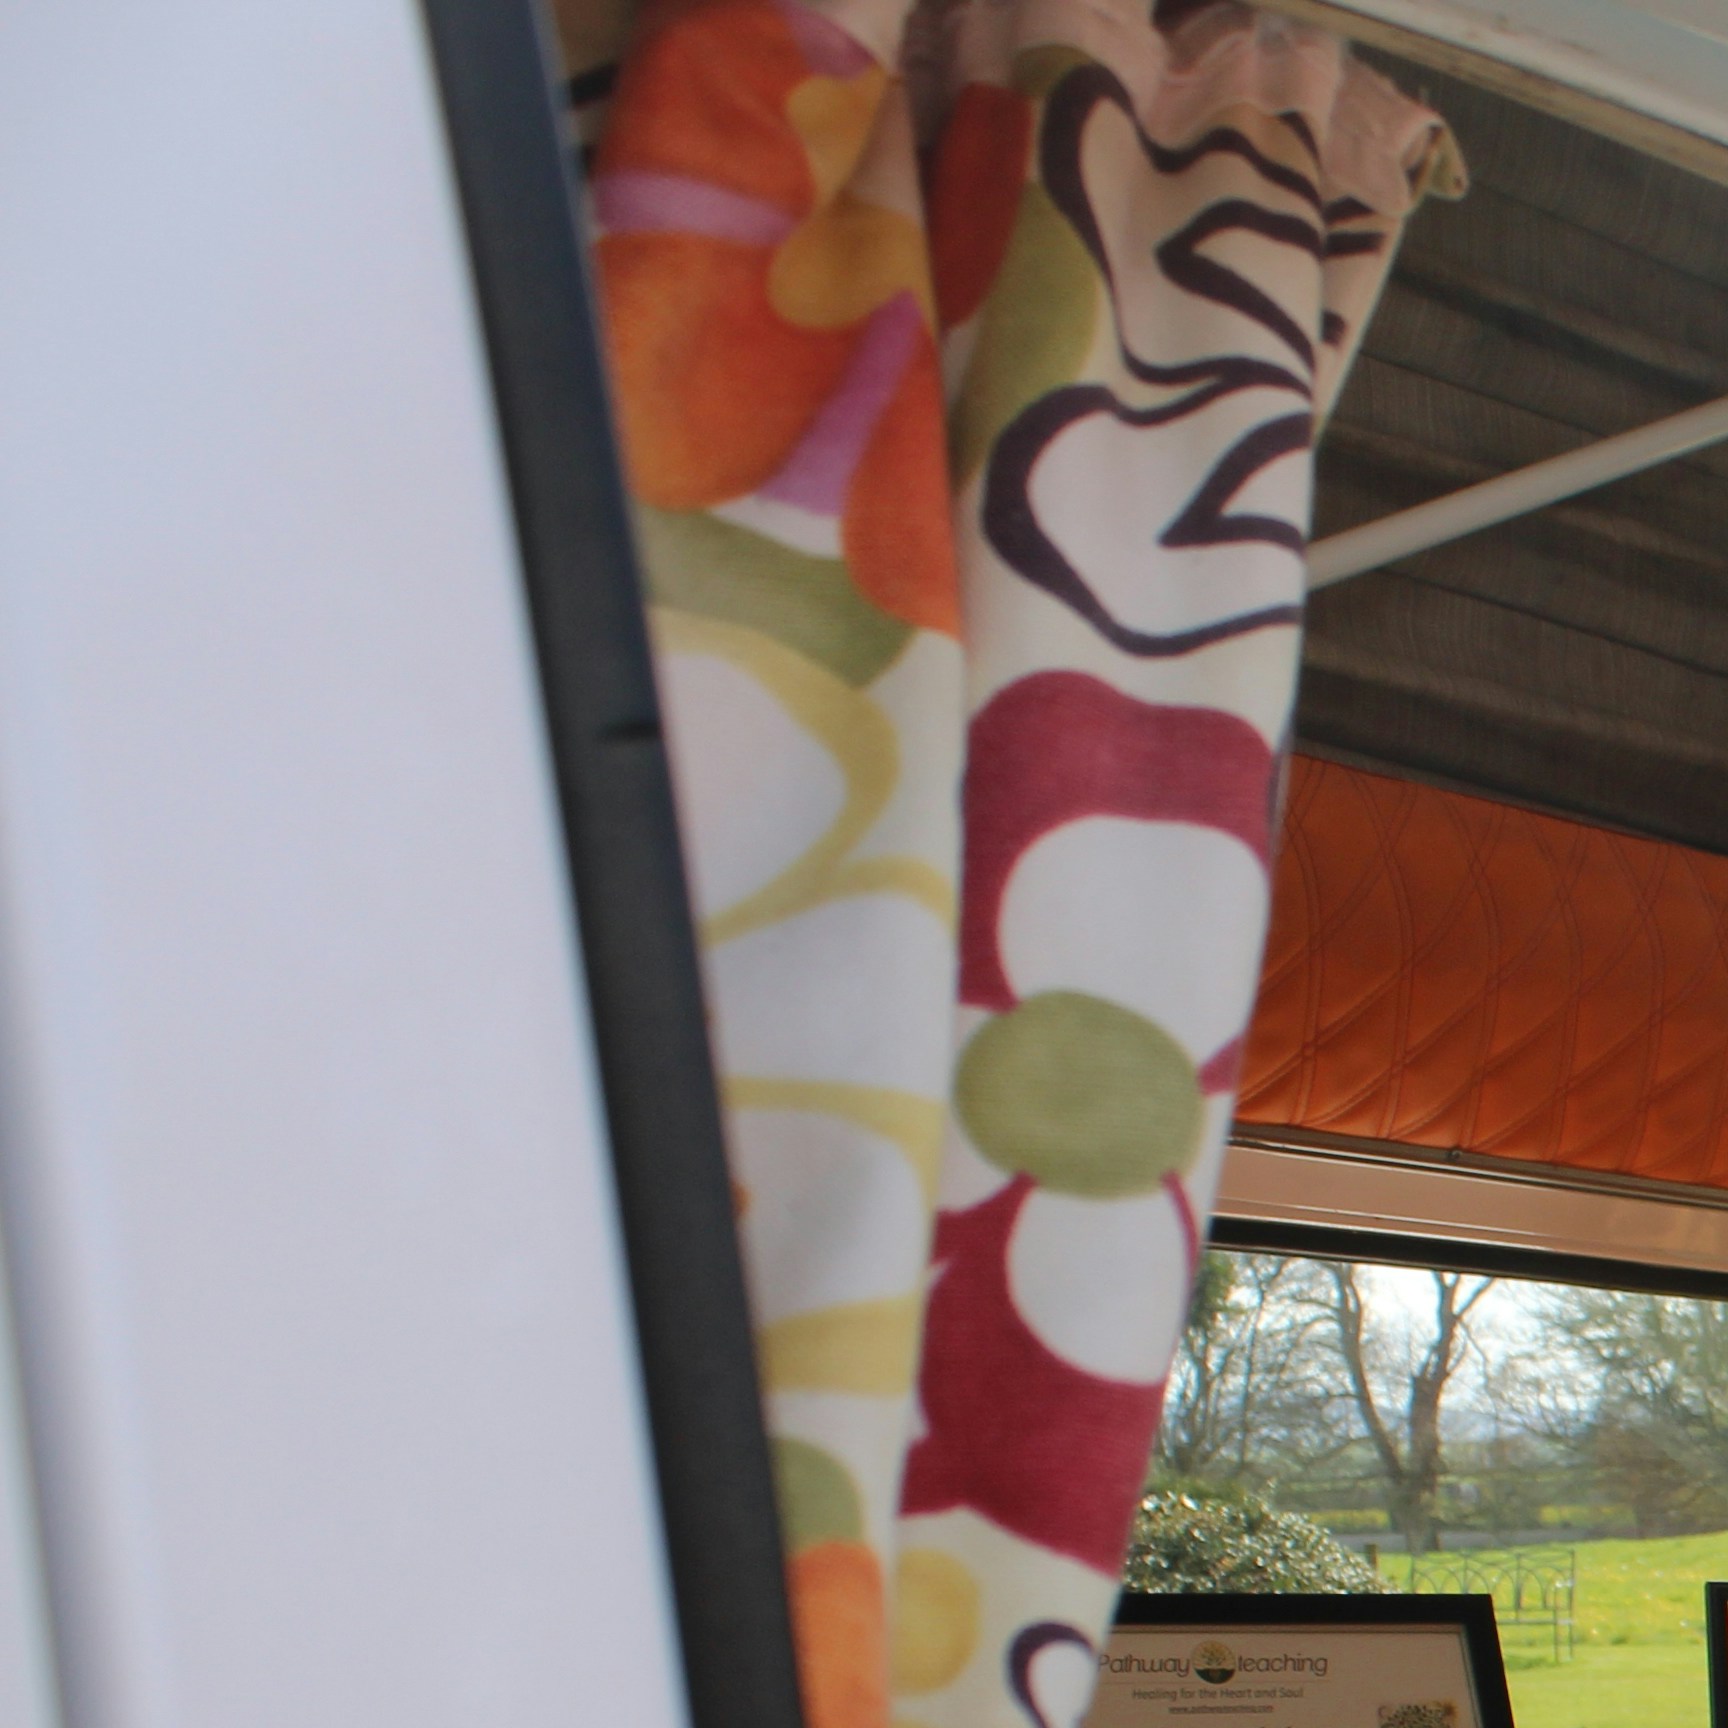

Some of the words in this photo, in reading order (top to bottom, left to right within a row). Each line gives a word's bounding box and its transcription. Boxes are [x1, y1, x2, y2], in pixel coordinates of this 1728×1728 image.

[1099, 1653, 1190, 1679] Pathway
[1238, 1652, 1328, 1677] teaching
[1132, 1687, 1179, 1702] Healing
[1180, 1687, 1196, 1699] for
[1199, 1687, 1217, 1699] the
[1220, 1687, 1253, 1699] Heart
[1254, 1687, 1276, 1699] and
[1278, 1686, 1304, 1699] Soul
